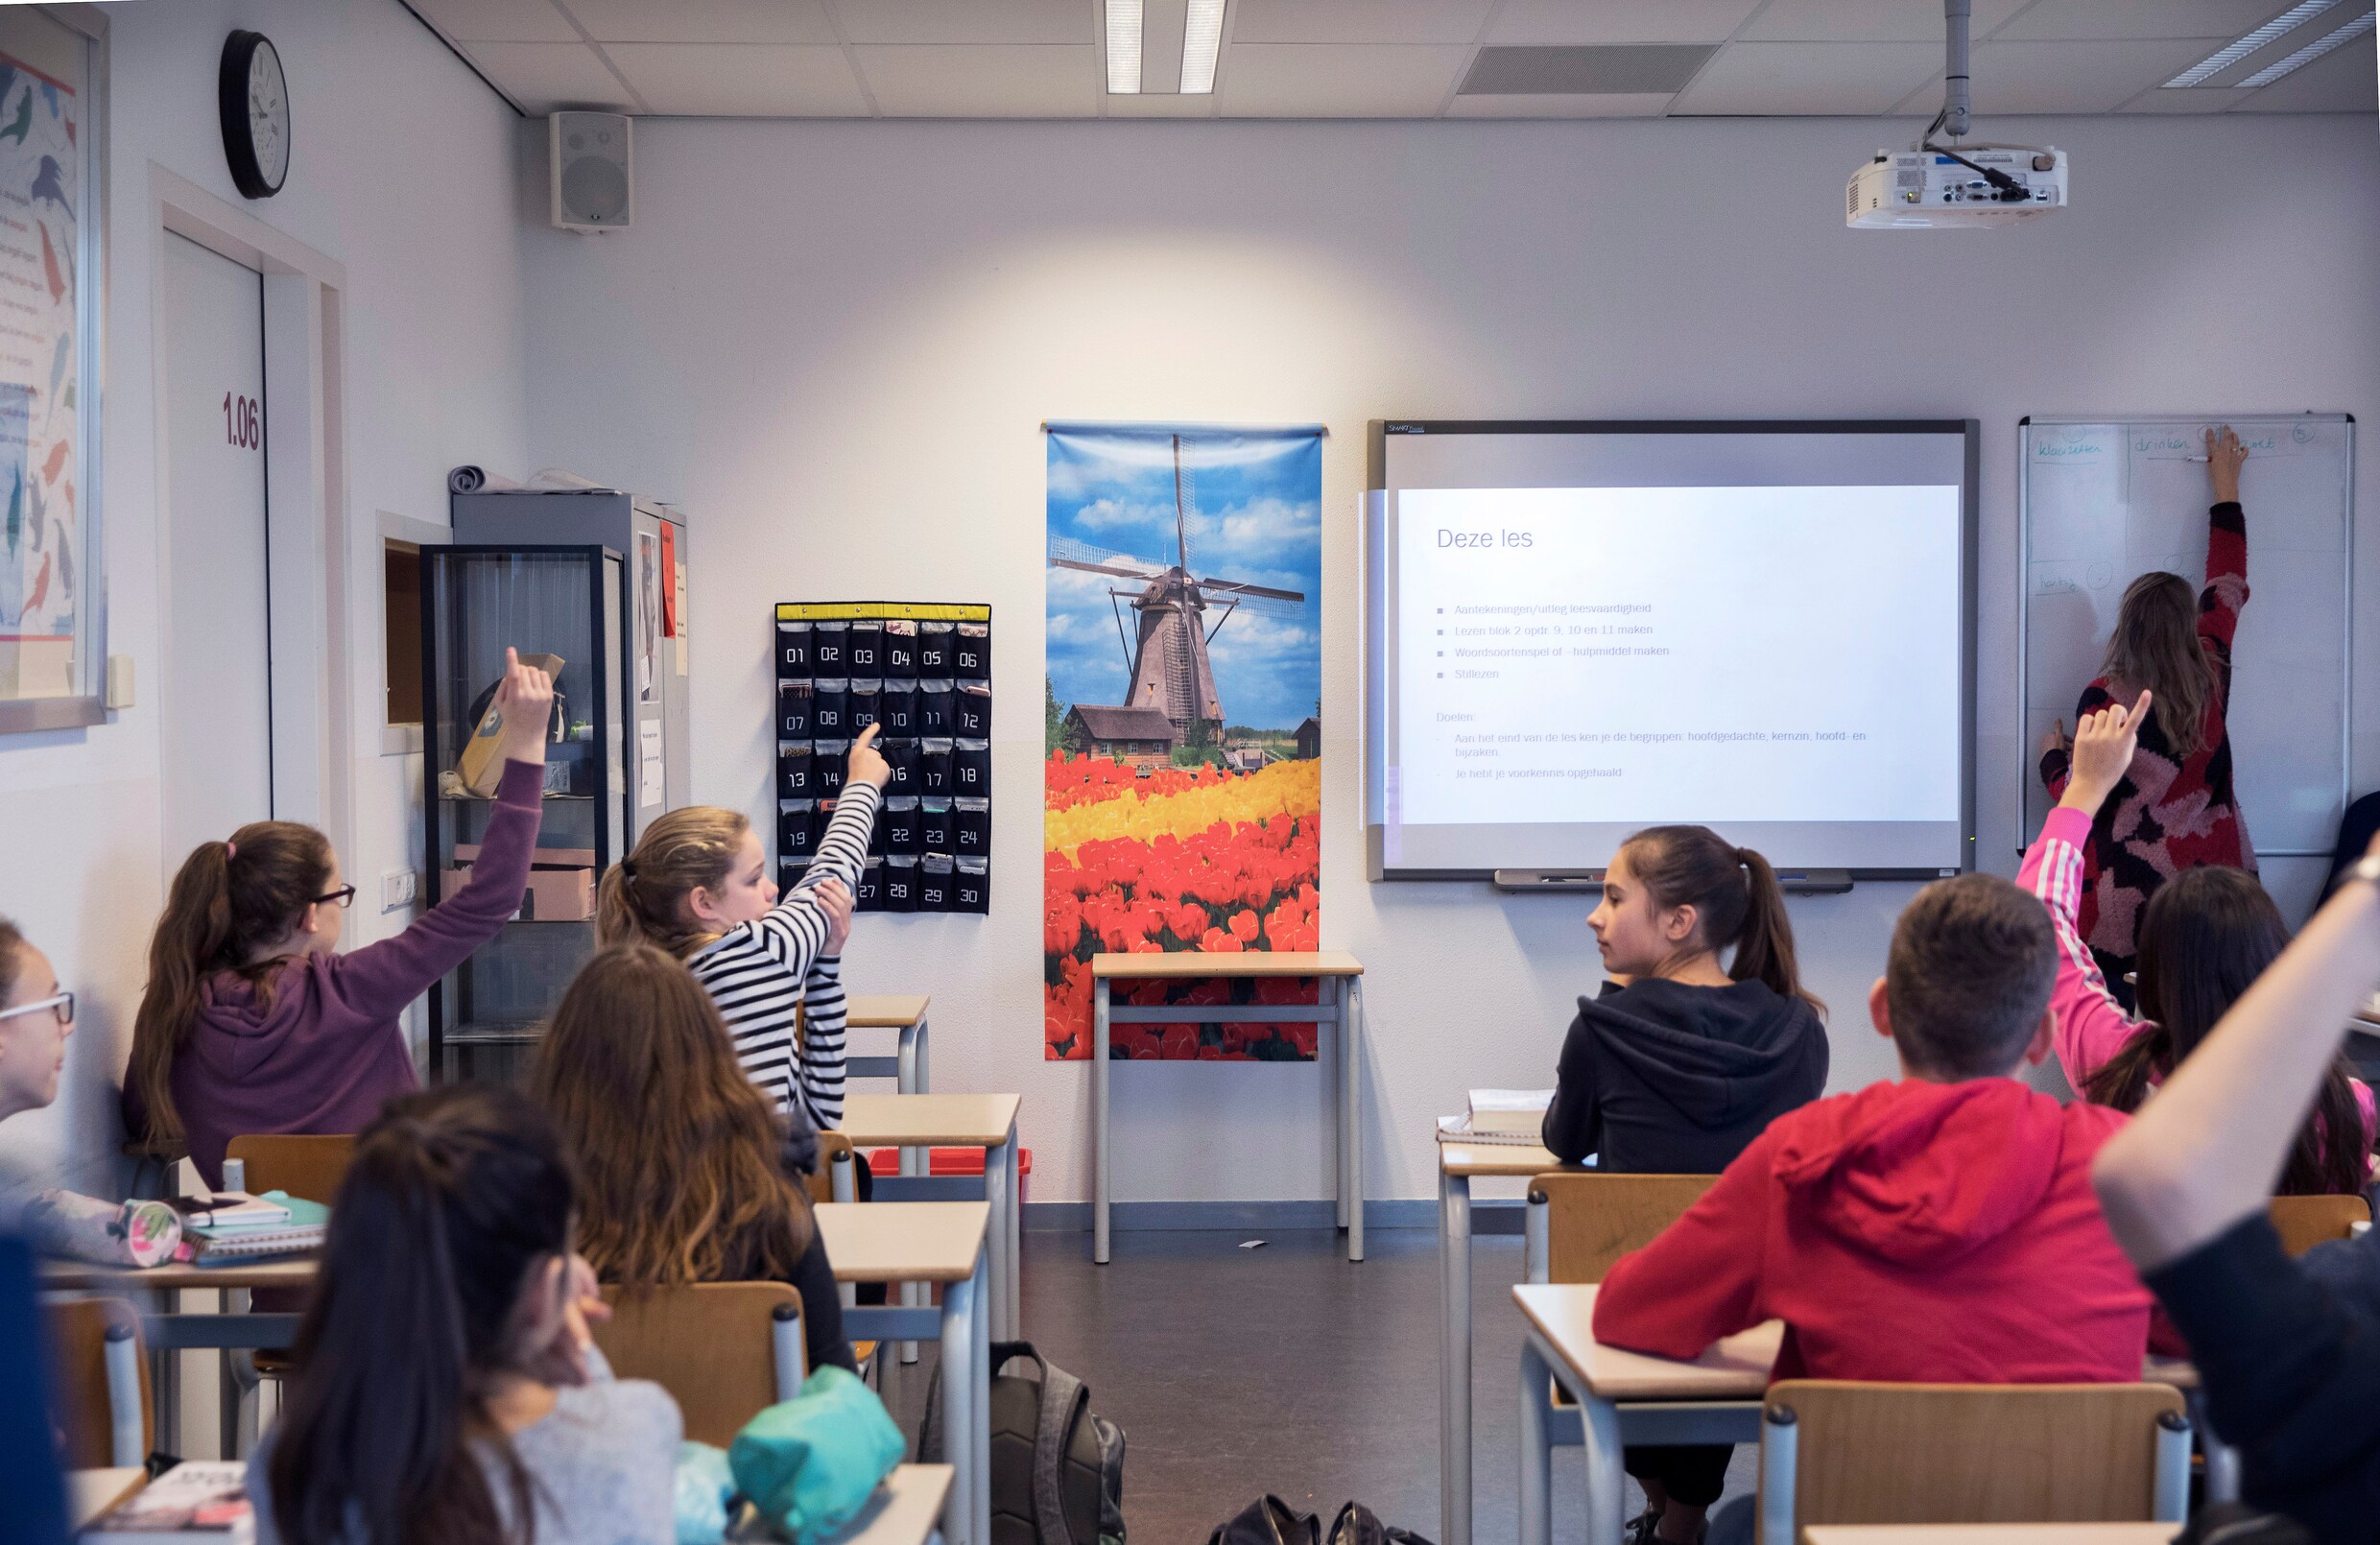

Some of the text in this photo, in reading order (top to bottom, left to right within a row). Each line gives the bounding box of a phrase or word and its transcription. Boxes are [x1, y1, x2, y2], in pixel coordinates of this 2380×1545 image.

[223, 391, 259, 451] 1.06
[1438, 529, 1534, 548] Deze les
[1454, 603, 1652, 616] Aantekeningen/uitleg leesvaardigheid
[1455, 626, 1486, 637] Lezen
[1488, 625, 1511, 636] blok
[1512, 626, 1521, 636] 2
[1554, 625, 1564, 638] 9,
[1567, 625, 1581, 636] 10
[1584, 627, 1597, 635] en
[1602, 625, 1614, 635] 11
[1617, 625, 1653, 635] maken
[787, 649, 802, 662] 01
[821, 648, 838, 660] 02
[856, 650, 872, 663] 03
[892, 651, 910, 665] 04
[924, 652, 940, 664] 05
[1454, 647, 1549, 659] Woordsoortenspel
[1552, 647, 1562, 657] of
[1633, 646, 1669, 656] maken
[960, 653, 976, 667] 06
[1454, 668, 1499, 679] Stillezen
[787, 717, 803, 729] 07
[821, 711, 837, 725] 08
[856, 713, 873, 726] 09
[892, 713, 906, 726] 10
[927, 712, 940, 724] 11
[964, 713, 978, 727] 12
[1455, 733, 1475, 744] Aan
[1478, 732, 1494, 743] het
[1497, 732, 1520, 743] eind
[1523, 734, 1541, 743] van
[1545, 732, 1559, 743] de
[1560, 732, 1577, 742] les
[1579, 732, 1598, 742] ken
[1601, 732, 1611, 744] je
[1613, 732, 1627, 742] de
[1687, 731, 1770, 744] hoofdgedachte,
[1772, 731, 1813, 743] kernzin,
[1852, 733, 1867, 742] en
[790, 772, 804, 787] 13
[824, 773, 839, 785] 14
[891, 767, 906, 781] 16
[927, 773, 941, 786] 17
[961, 769, 976, 781] 18
[1456, 767, 1622, 780] Je hebt je voorkennis opgehaald
[790, 832, 805, 845] 19
[892, 829, 909, 841] 22
[927, 830, 943, 843] 23
[961, 831, 977, 844] 24
[859, 885, 875, 898] 27
[891, 884, 906, 897] 28
[925, 890, 941, 902] 29
[961, 890, 977, 902] 30
